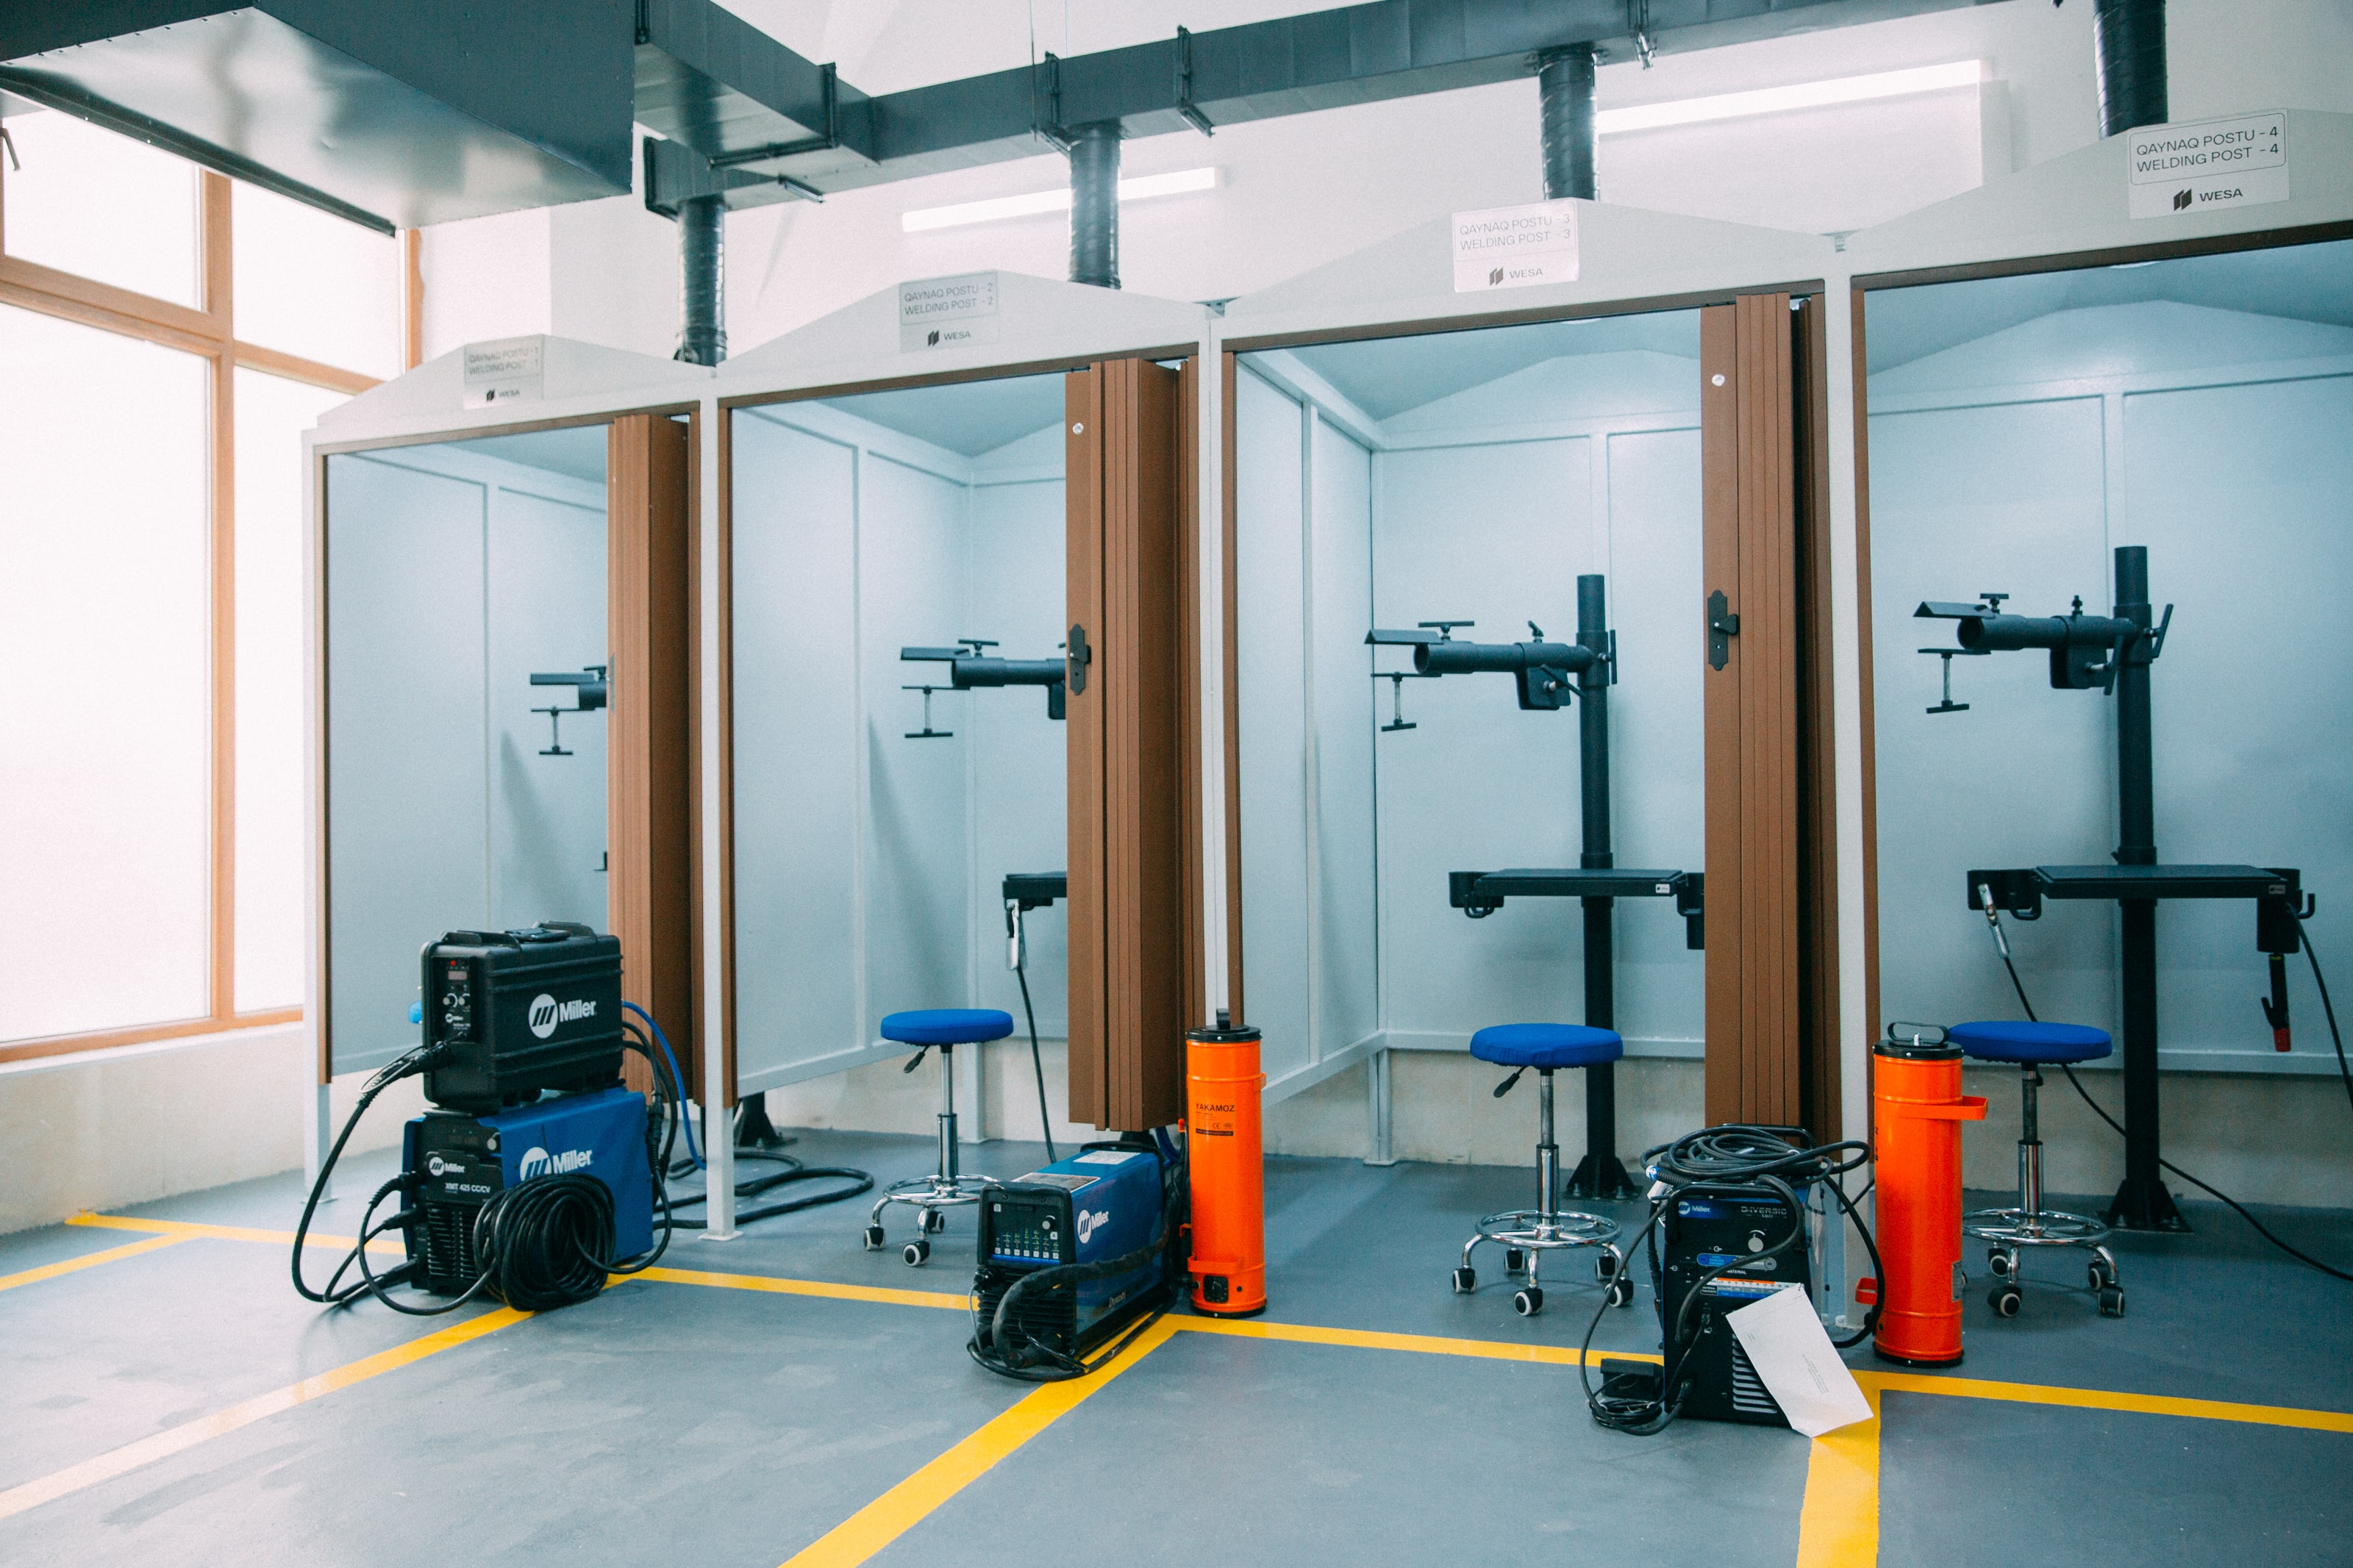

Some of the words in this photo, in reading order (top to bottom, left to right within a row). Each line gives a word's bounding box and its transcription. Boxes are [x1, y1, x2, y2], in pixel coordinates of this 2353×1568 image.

[2137, 138, 2199, 155] QAYNAQ
[2203, 129, 2254, 147] POSTU
[2270, 126, 2278, 137] 4
[2137, 154, 2207, 172] WELDING
[2211, 147, 2252, 162] POST
[2270, 143, 2279, 154] 4
[2199, 188, 2243, 202] WESA
[1460, 221, 1509, 235] QAYNAQ
[1512, 215, 1552, 229] POSTU
[1563, 213, 1570, 223] 3
[1460, 235, 1515, 250] WELDING
[1518, 231, 1550, 243] POST
[1563, 229, 1571, 239] 3
[1509, 268, 1543, 279] WESA
[904, 289, 943, 302] QAYNAQ
[946, 284, 978, 296] POSTU
[987, 282, 993, 292] 2
[904, 301, 949, 315] WELDING
[951, 298, 977, 309] POST
[988, 296, 993, 305] 2
[943, 331, 971, 340] WESA
[559, 999, 597, 1023] Miller
[1196, 1103, 1235, 1112] YAKAMOZ
[444, 1162, 465, 1173] Miller
[552, 1149, 593, 1174] Miller
[445, 1182, 459, 1191] XMT
[459, 1184, 471, 1192] 425
[1740, 1206, 1787, 1214] DIVERSIO
[1091, 1211, 1109, 1229] Miller
